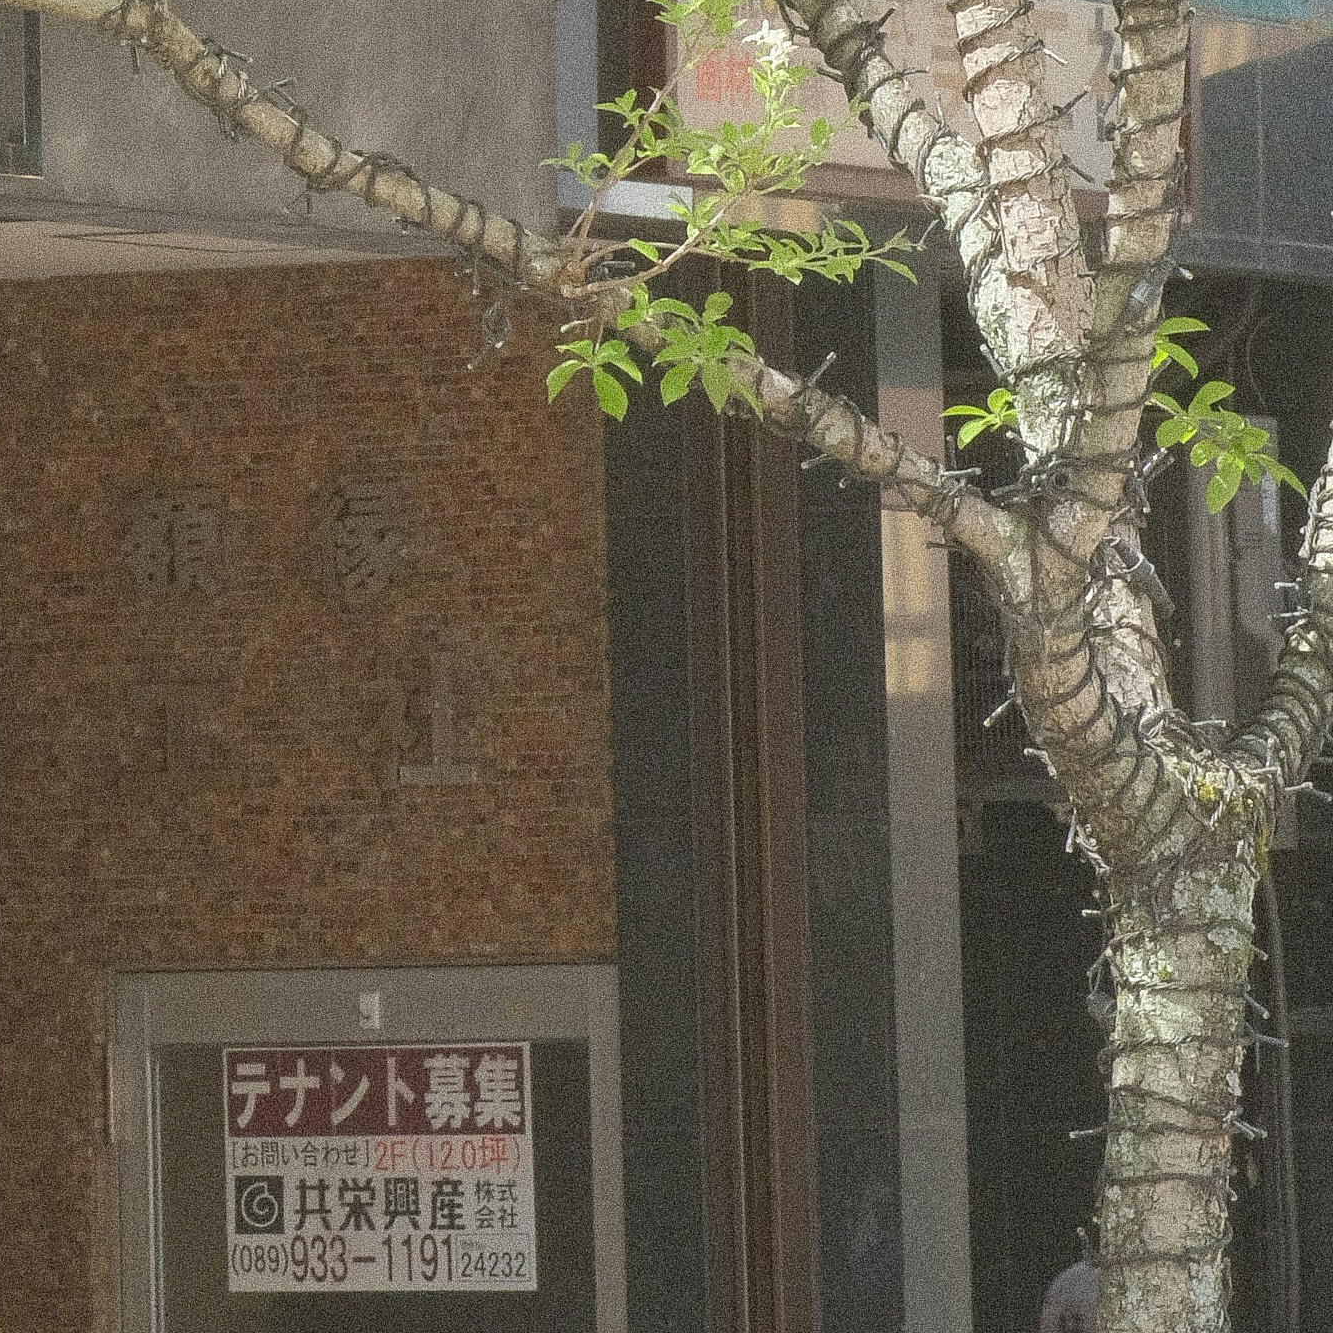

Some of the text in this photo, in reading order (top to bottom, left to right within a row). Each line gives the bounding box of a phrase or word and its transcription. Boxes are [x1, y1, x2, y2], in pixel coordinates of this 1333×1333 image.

[231, 1053, 522, 1131] テナント募集
[294, 1176, 467, 1232] 共栄興産
[460, 1250, 527, 1278] 24232
